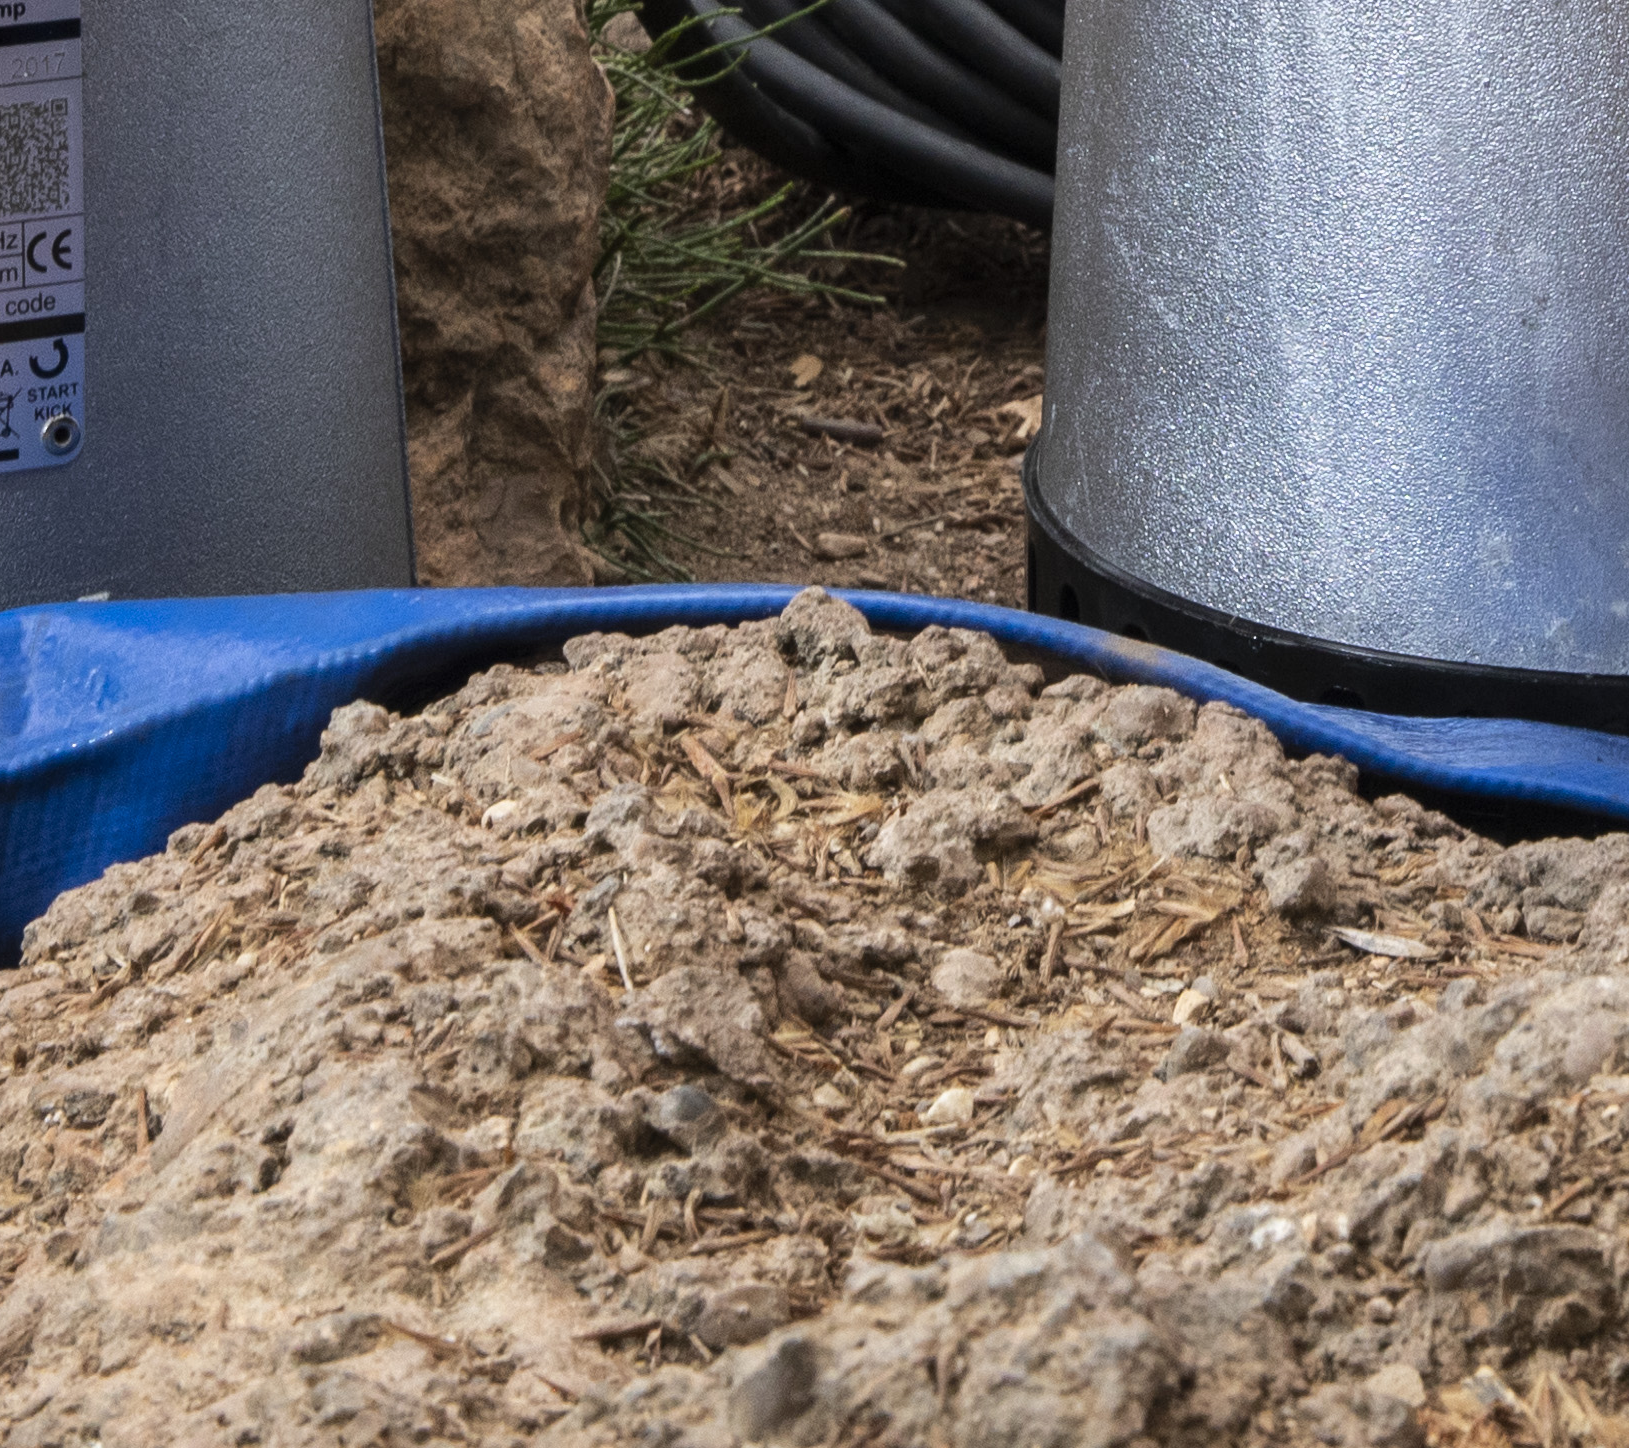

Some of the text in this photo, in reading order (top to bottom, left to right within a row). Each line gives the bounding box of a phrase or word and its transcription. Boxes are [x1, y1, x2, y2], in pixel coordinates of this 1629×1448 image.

[11, 51, 66, 80] 2017
[27, 229, 72, 273] CE
[5, 292, 57, 316] code
[27, 383, 80, 403] START
[34, 403, 73, 421] KICK
